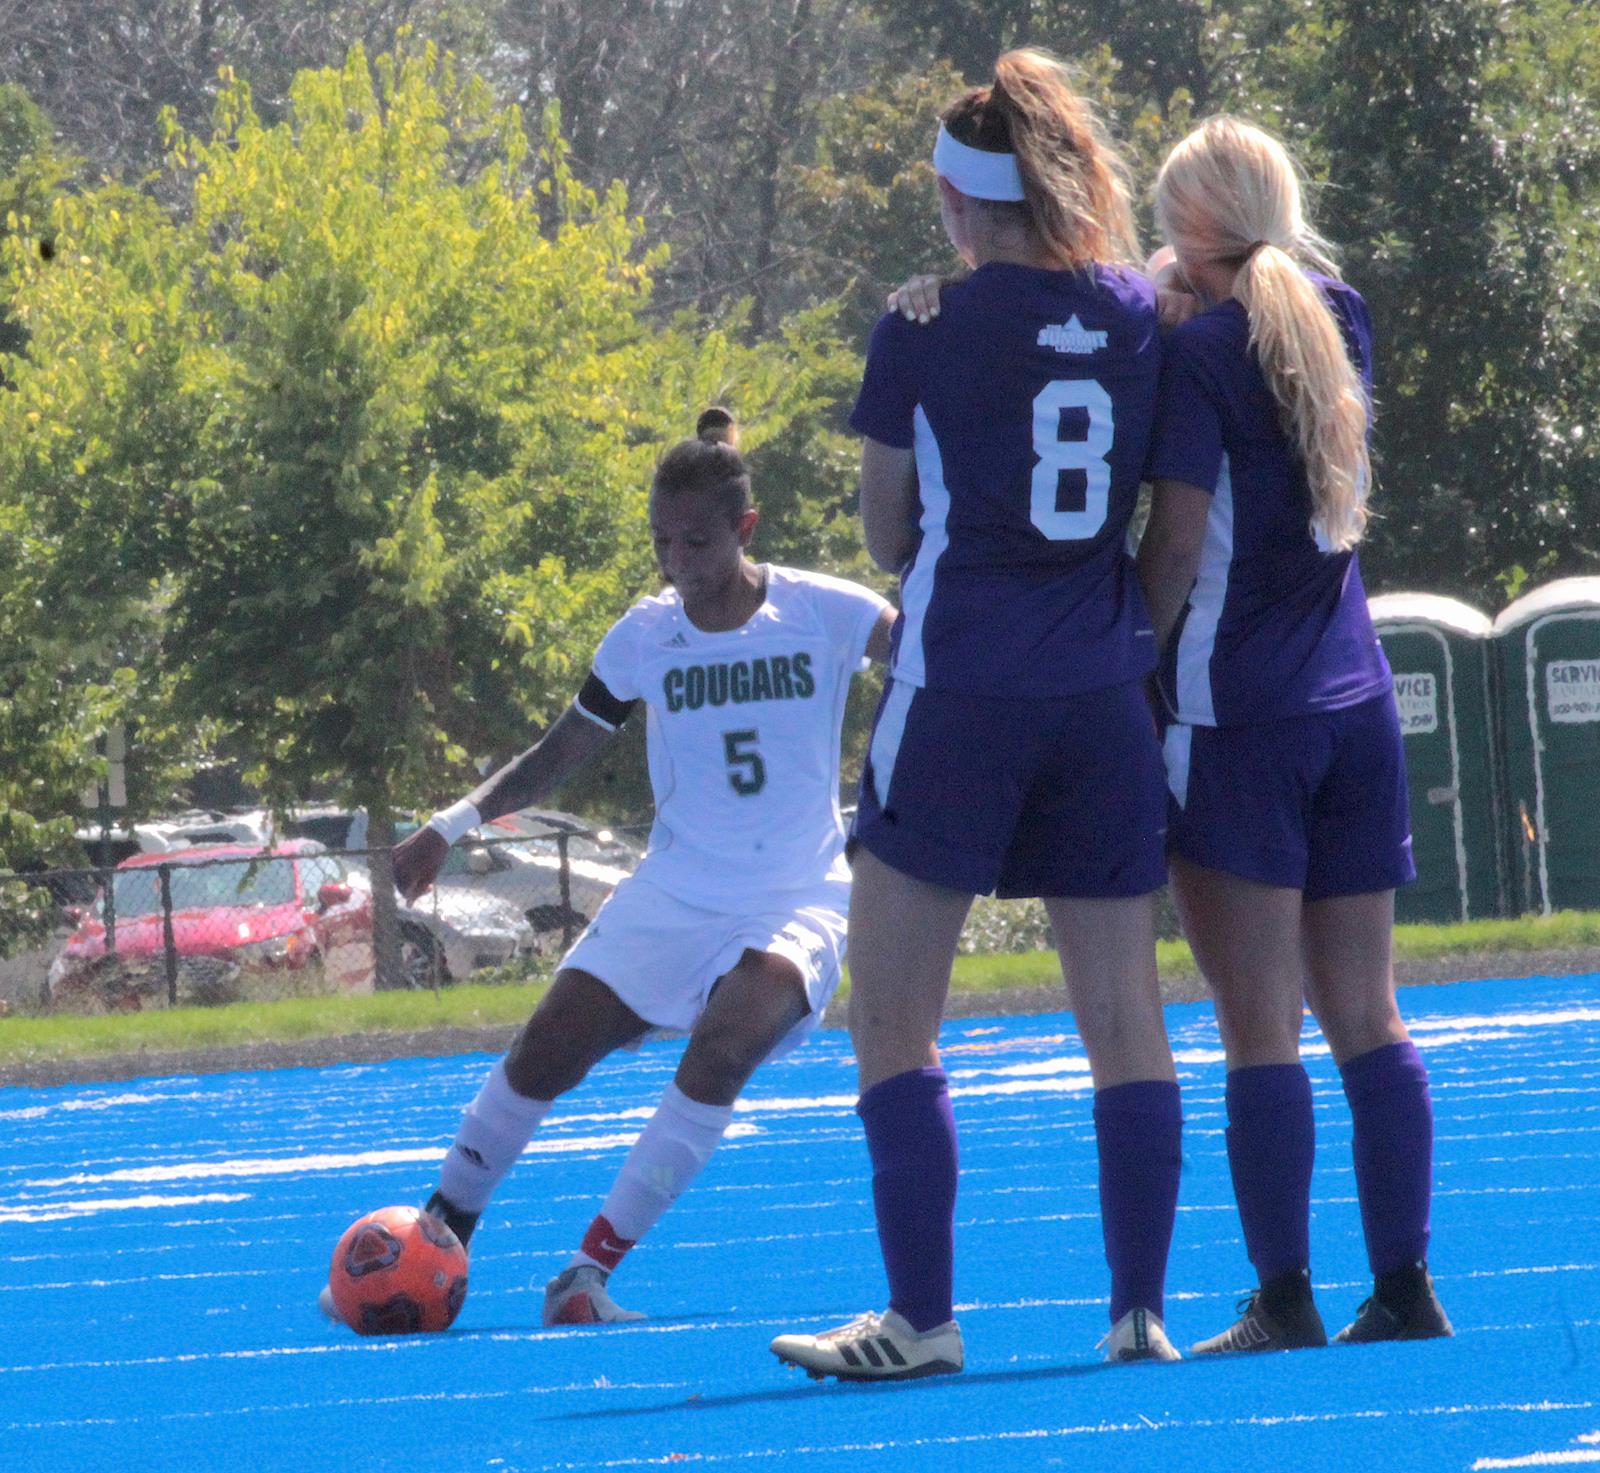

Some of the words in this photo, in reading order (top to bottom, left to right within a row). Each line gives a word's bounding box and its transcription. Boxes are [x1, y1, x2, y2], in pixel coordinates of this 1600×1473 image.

[1030, 379, 1114, 541] 8
[663, 652, 815, 713] COUGARS
[1394, 678, 1432, 696] VICE
[723, 729, 766, 795] 5
